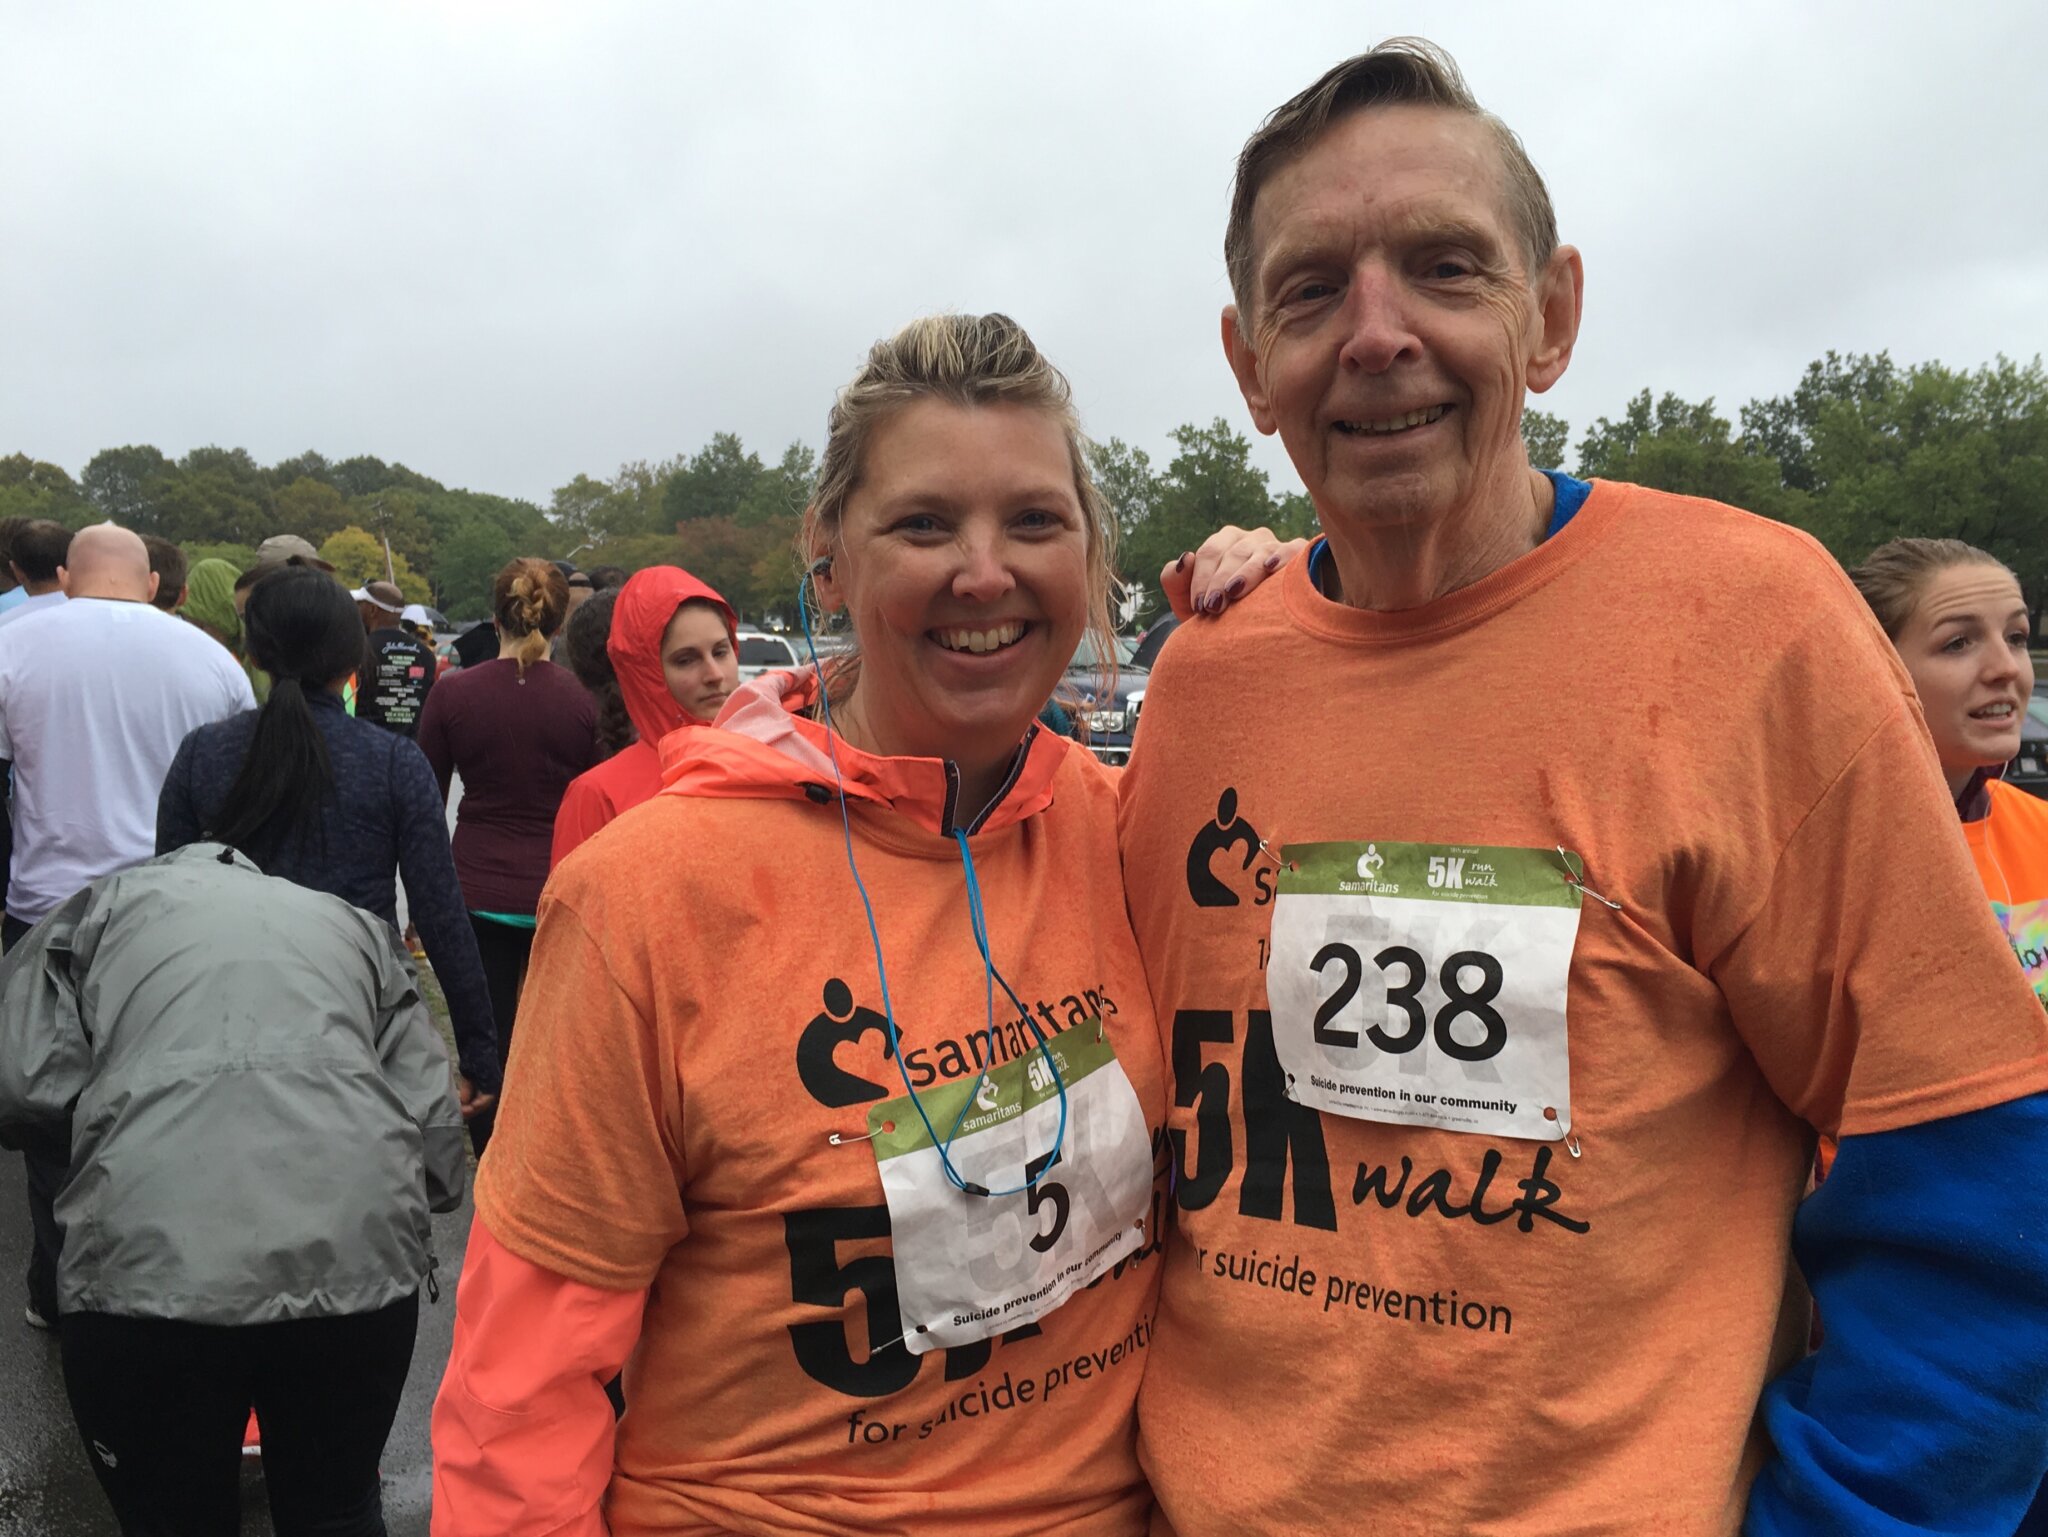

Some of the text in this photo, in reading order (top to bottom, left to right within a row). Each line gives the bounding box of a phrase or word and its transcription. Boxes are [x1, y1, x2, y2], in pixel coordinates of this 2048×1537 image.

[1339, 878, 1399, 894] samaritans
[1427, 856, 1495, 889] 5K run
[1465, 874, 1498, 887] walk
[904, 985, 1118, 1087] samaritans
[1309, 942, 1507, 1062] 238
[963, 1101, 1022, 1132] samaritans
[1310, 1075, 1337, 1091] Suicide
[1339, 1082, 1396, 1101] prevention
[1400, 1089, 1411, 1101] in
[1414, 1094, 1437, 1105] our
[1440, 1095, 1518, 1115] community
[1025, 1148, 1070, 1253] 5
[1352, 1145, 1591, 1235] walk
[953, 1230, 1123, 1327] Suicide prevention in our community
[1213, 1249, 1317, 1297] suicide
[1323, 1273, 1513, 1335] prevention
[847, 1408, 907, 1444] for
[1043, 1314, 1152, 1402] preventi
